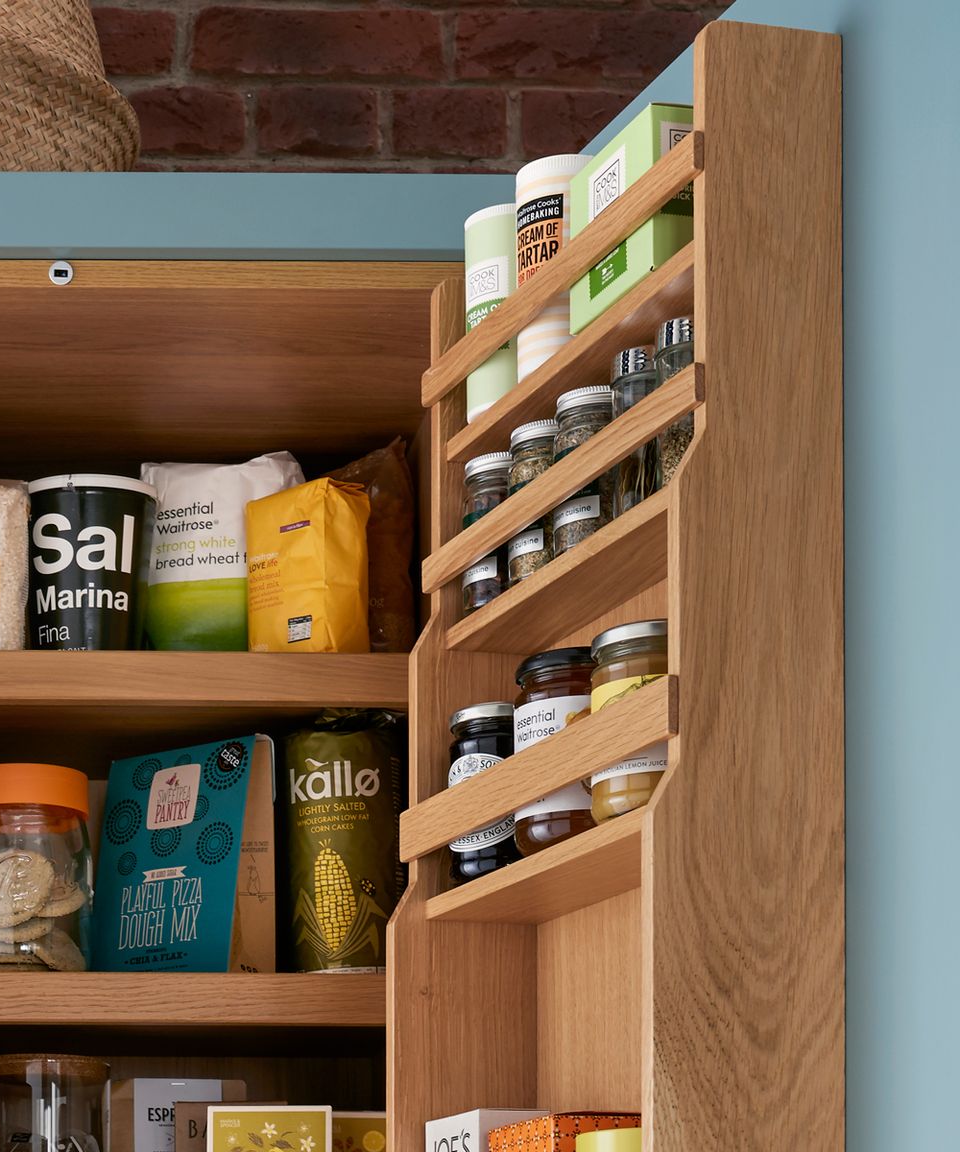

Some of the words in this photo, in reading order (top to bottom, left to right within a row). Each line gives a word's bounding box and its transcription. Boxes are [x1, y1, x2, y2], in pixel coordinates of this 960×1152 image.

[595, 167, 617, 193] COOK
[518, 224, 544, 250] CREAM
[546, 222, 559, 236] OF
[518, 240, 559, 273] TARTAR
[156, 501, 214, 521] essential
[156, 520, 213, 535] Waitrose
[32, 513, 135, 575] Sal
[155, 540, 196, 554] strong
[199, 536, 236, 549] white
[155, 553, 194, 570] bread
[197, 552, 240, 565] wheat
[35, 582, 129, 615] Marina
[39, 624, 71, 645] Fina
[517, 708, 556, 730] essential
[516, 725, 555, 742] Waitrose
[220, 749, 240, 768] taste
[154, 800, 191, 824] PANTRY
[299, 804, 331, 816] LIGHTLY
[333, 802, 366, 812] SALTED
[310, 825, 330, 833] CORN
[331, 823, 354, 831] CAKES
[121, 881, 166, 914] PLAYFUL
[171, 877, 203, 907] PIZZA
[118, 909, 166, 950] DOUGH
[170, 904, 201, 944] MIX
[147, 1107, 175, 1121] ESPR
